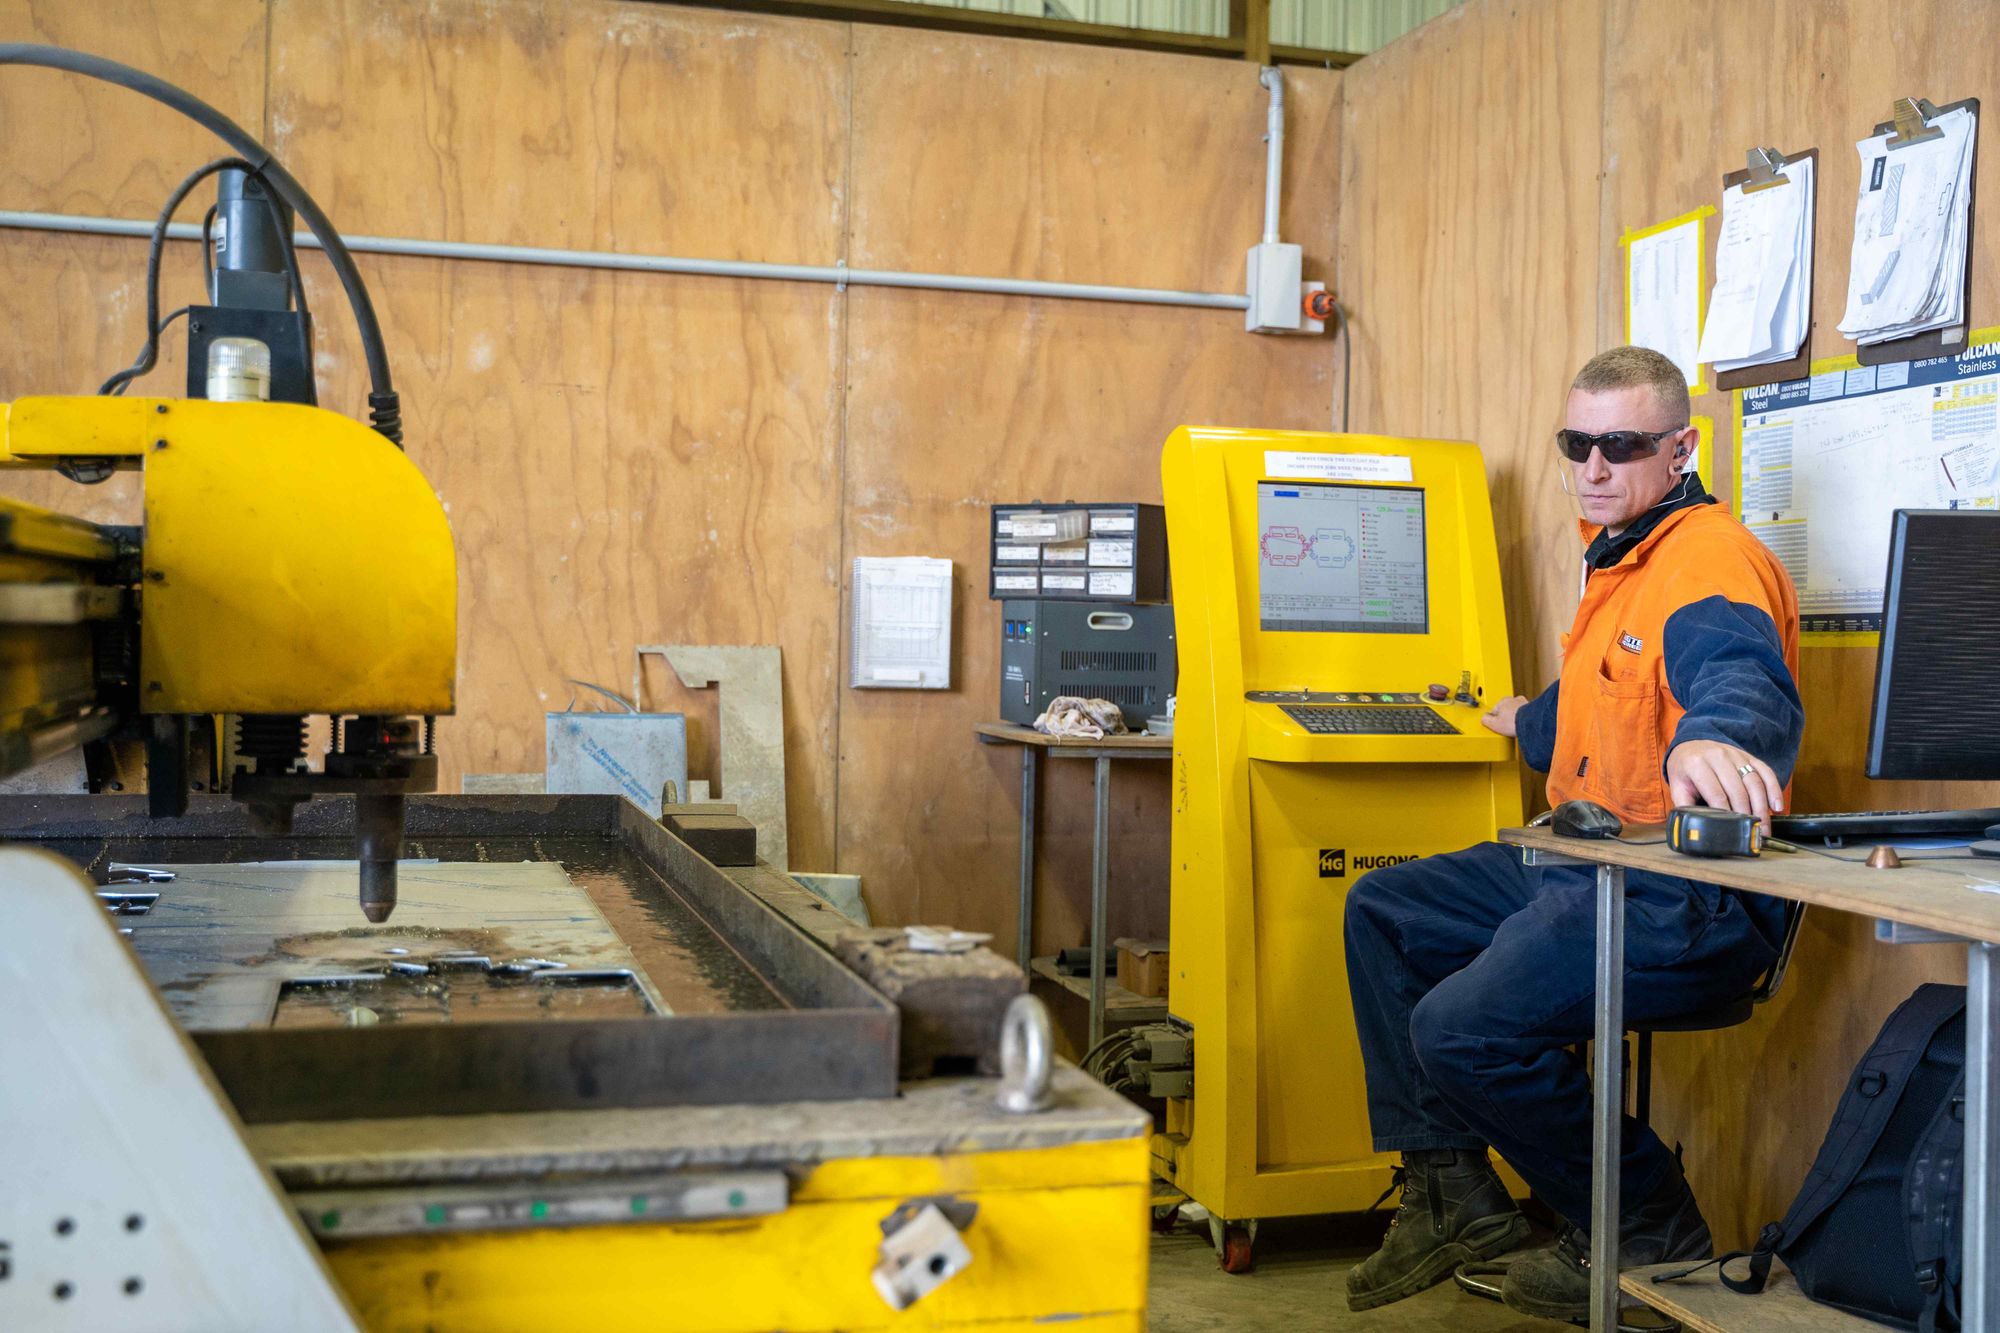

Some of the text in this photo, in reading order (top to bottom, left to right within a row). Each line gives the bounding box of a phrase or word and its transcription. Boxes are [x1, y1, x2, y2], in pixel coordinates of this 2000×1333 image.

[1914, 356, 1947, 368] 0800 782 465
[1958, 360, 1996, 375] Stainless
[1743, 383, 1778, 400] VULCAN
[1752, 398, 1768, 410] Steel
[1321, 858, 1343, 871] HG
